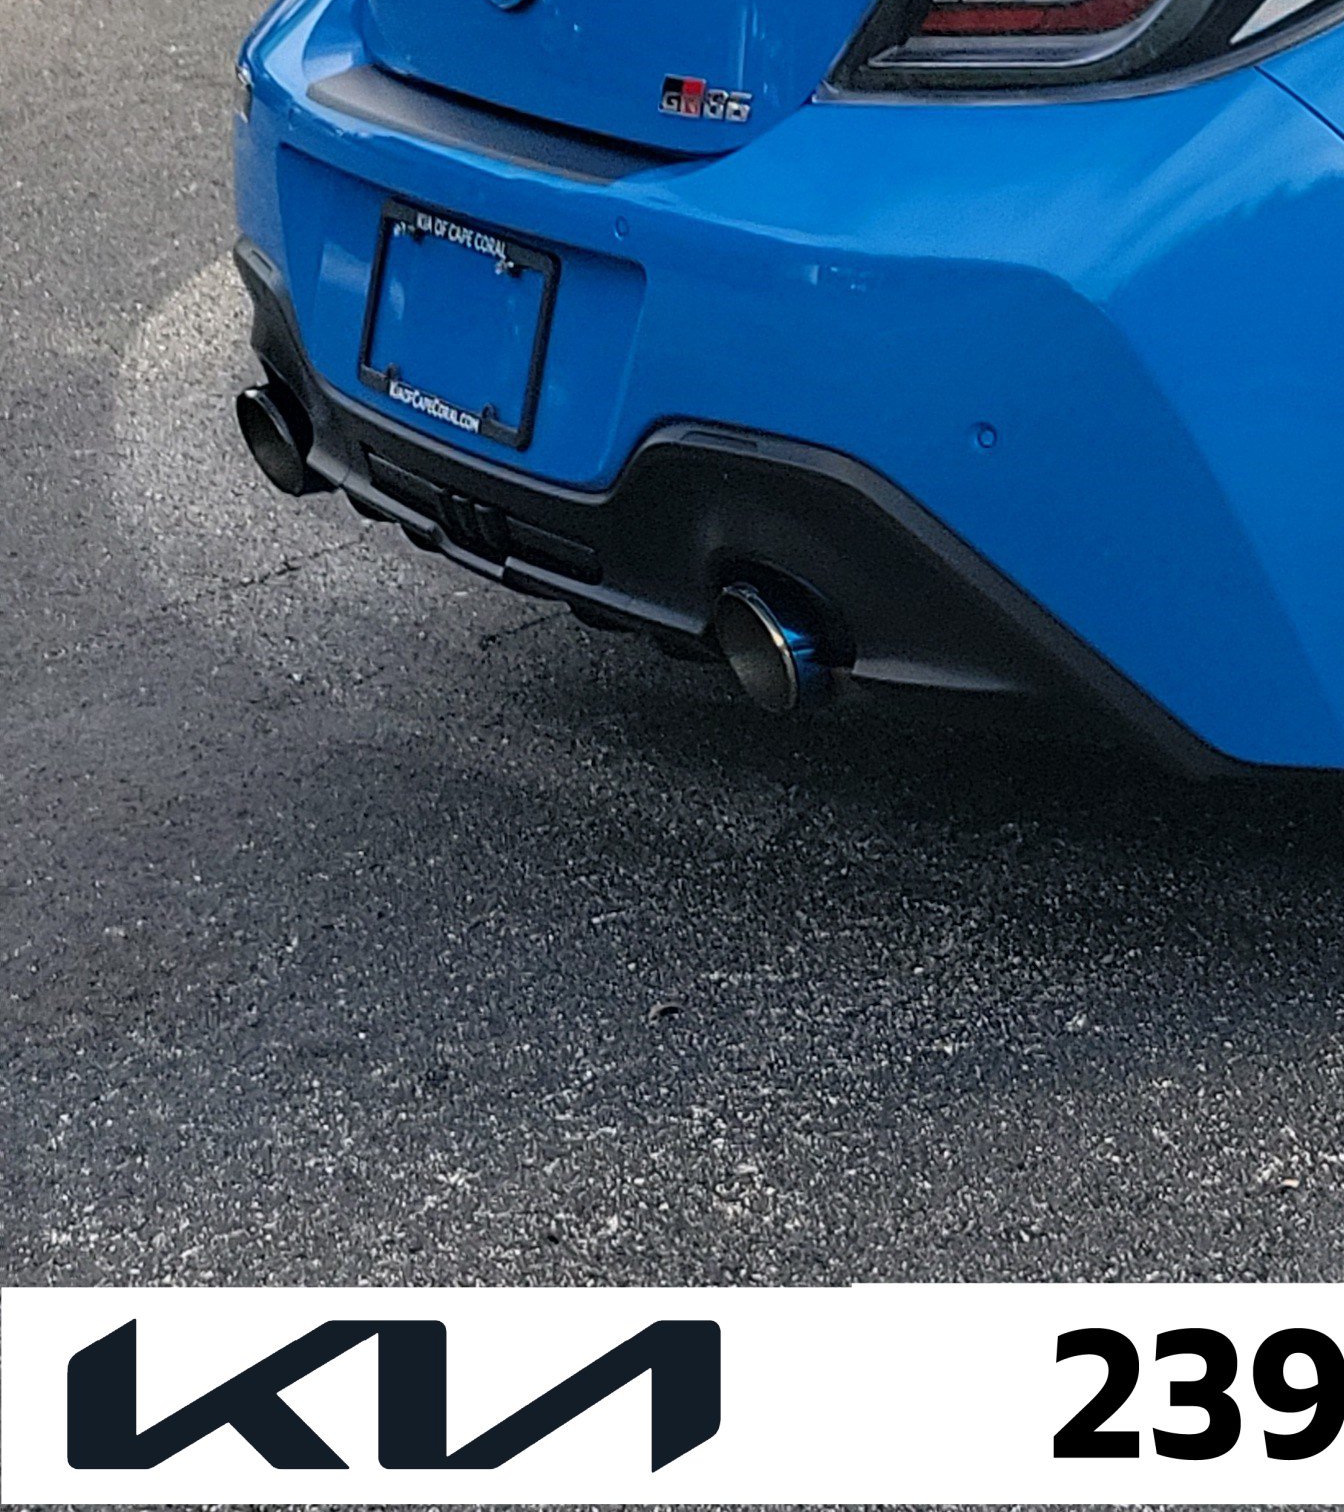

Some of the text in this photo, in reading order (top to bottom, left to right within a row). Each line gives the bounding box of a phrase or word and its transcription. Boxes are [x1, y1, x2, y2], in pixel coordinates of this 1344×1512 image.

[417, 212, 506, 259] KIA OF CAPE CORAL
